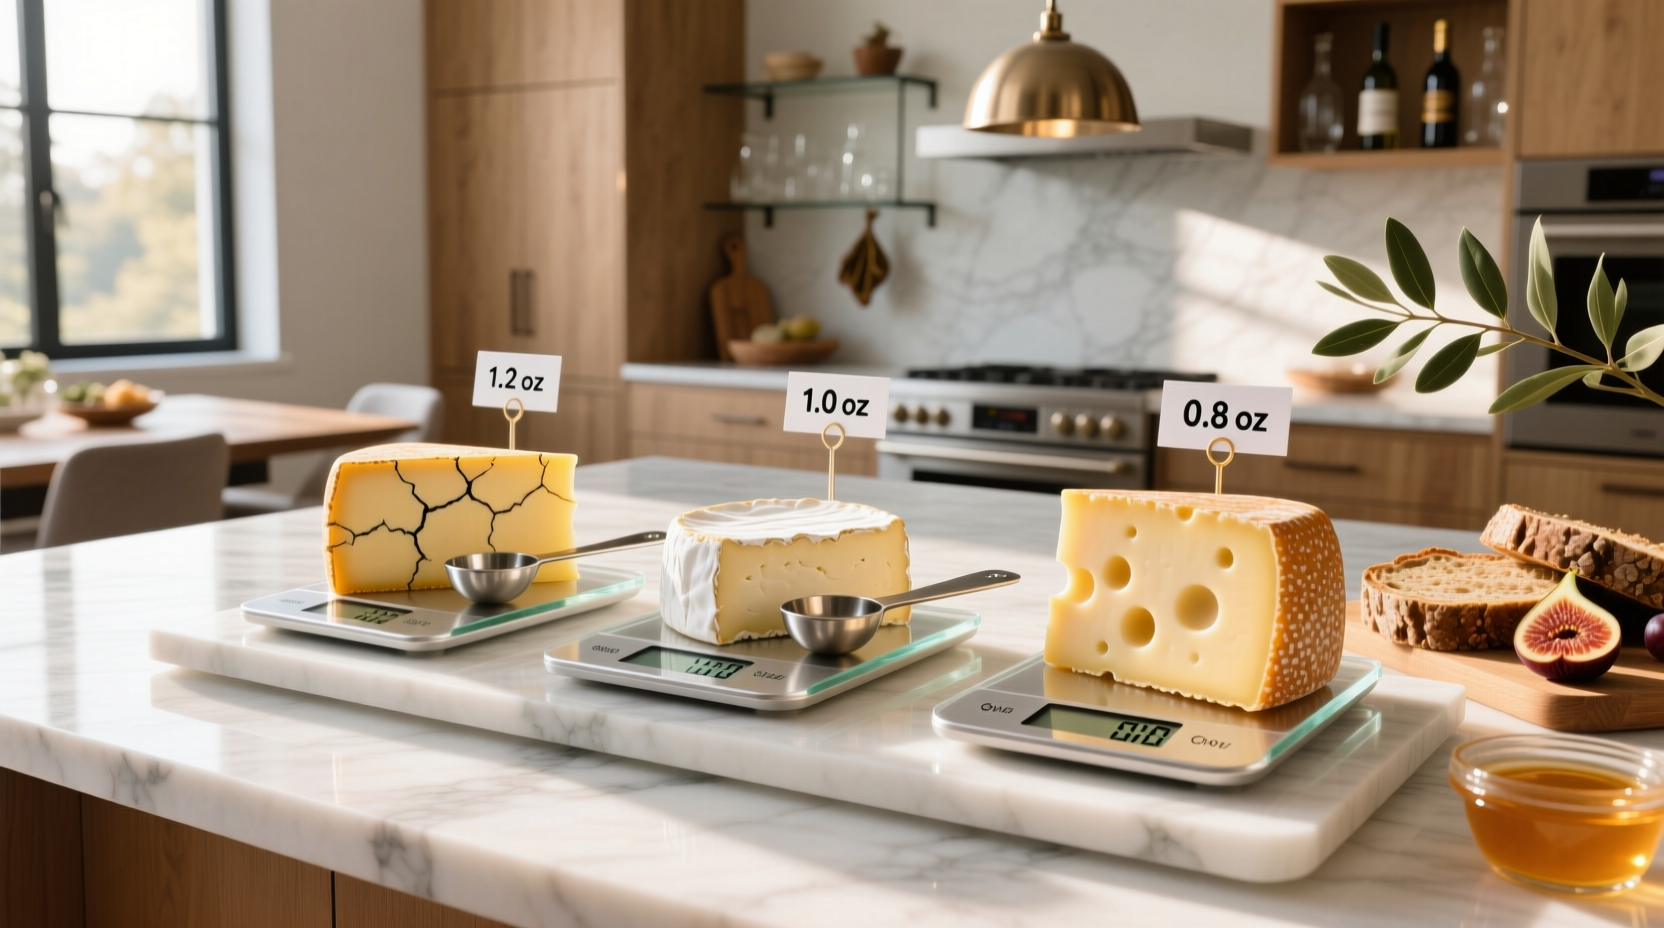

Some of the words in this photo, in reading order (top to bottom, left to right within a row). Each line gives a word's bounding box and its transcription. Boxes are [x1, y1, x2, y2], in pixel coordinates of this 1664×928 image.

[489, 366, 517, 389] 1.2
[521, 375, 545, 392] oz
[803, 387, 837, 414] 1.0
[842, 398, 870, 417] oz
[1183, 399, 1229, 430] 0.8
[1235, 411, 1269, 432] oz
